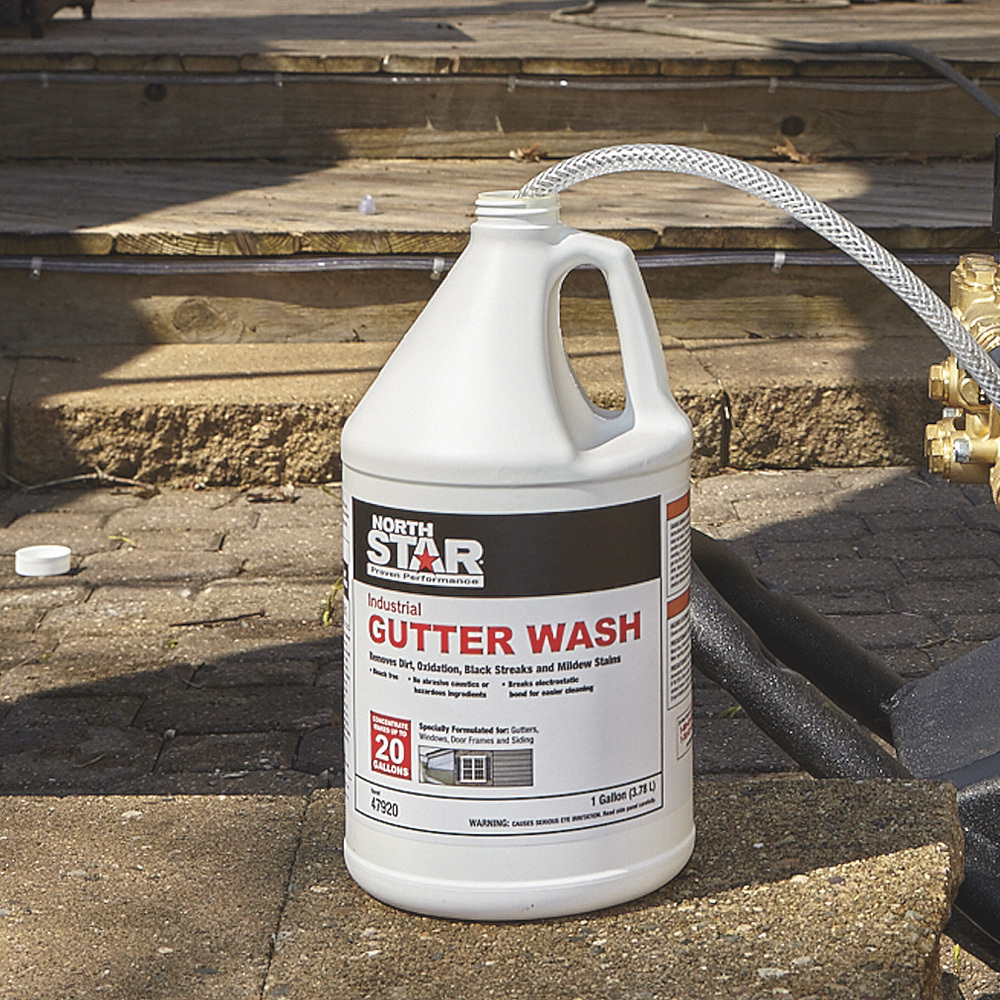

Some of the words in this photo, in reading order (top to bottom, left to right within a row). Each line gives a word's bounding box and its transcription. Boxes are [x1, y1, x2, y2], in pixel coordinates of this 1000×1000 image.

[372, 514, 434, 537] NORTH
[366, 530, 483, 574] STAR
[371, 566, 400, 578] Proven
[403, 573, 479, 585] Performance
[368, 592, 422, 616] Industrial
[368, 615, 515, 656] GUTTER
[526, 610, 642, 654] WASH
[369, 651, 397, 666] Removes
[399, 658, 415, 672] Dirt,
[417, 660, 462, 675] Oxidation,
[464, 664, 492, 674] Black
[494, 664, 533, 674] Streaks
[536, 662, 554, 674] and
[558, 660, 592, 672] Mildew
[594, 655, 622, 667] Stains
[535, 676, 579, 686] electrostatic
[414, 686, 446, 696] hazardous
[448, 690, 486, 698] ingredients
[542, 688, 562, 696] easier
[565, 685, 594, 694] cleaning
[372, 716, 408, 730] CONCENTRATE
[419, 722, 450, 734] Specially
[452, 725, 494, 734] Formulated
[496, 726, 509, 734] for:
[511, 726, 539, 735] Gutters,
[398, 728, 408, 738] TO
[419, 733, 449, 744] Windows,
[450, 736, 466, 744] Door
[468, 736, 494, 744] Frames
[496, 736, 510, 744] and
[512, 736, 534, 746] Siding
[375, 734, 404, 764] 20
[373, 760, 409, 777] GALLONS
[591, 796, 596, 806] 1
[598, 791, 627, 806] Gallon
[370, 796, 398, 818] 47920
[468, 818, 510, 828] WARNING:
[536, 818, 560, 826] SERIOUS
